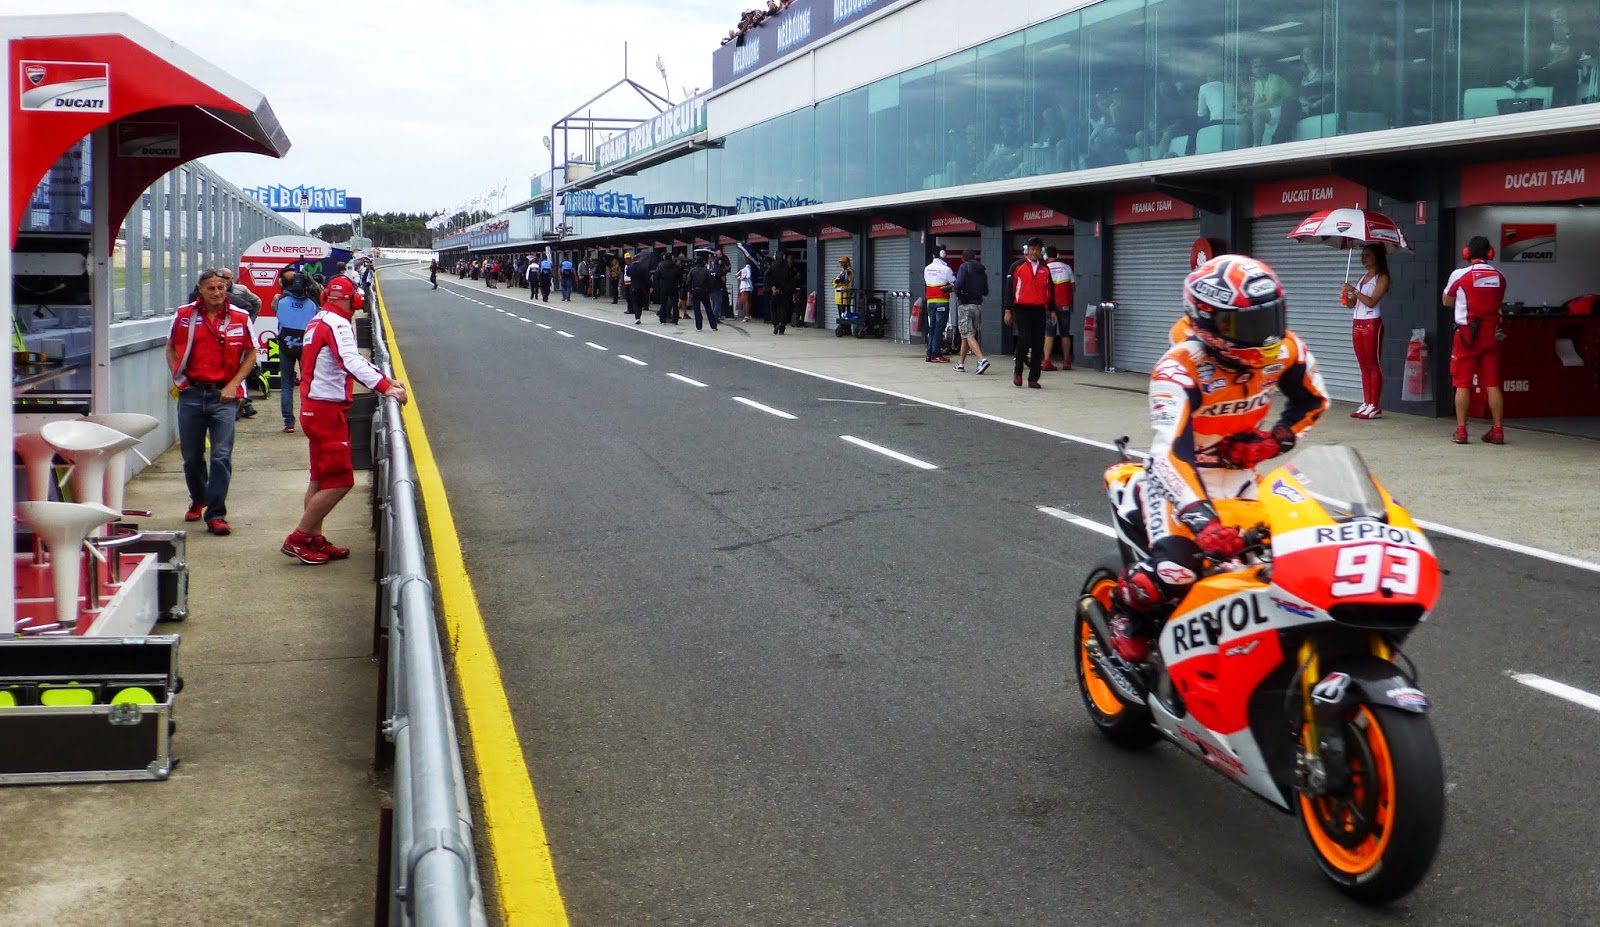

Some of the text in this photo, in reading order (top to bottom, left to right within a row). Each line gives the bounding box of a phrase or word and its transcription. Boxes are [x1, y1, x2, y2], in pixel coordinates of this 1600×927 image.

[55, 98, 104, 108] DUCATI
[600, 97, 704, 167] GRAND PRIX CIRCUIT
[1505, 168, 1585, 189] DUCATI TEAM
[1282, 187, 1333, 203] DUCATI TEAM
[1131, 200, 1172, 213] PRAMAC TEAM
[1023, 211, 1041, 221] PRAMAC
[1521, 251, 1553, 259] DUCATI
[1196, 281, 1232, 302] LOTUS
[1503, 380, 1529, 391] USAG
[1317, 523, 1416, 545] REPSOL
[1331, 543, 1420, 597] 93
